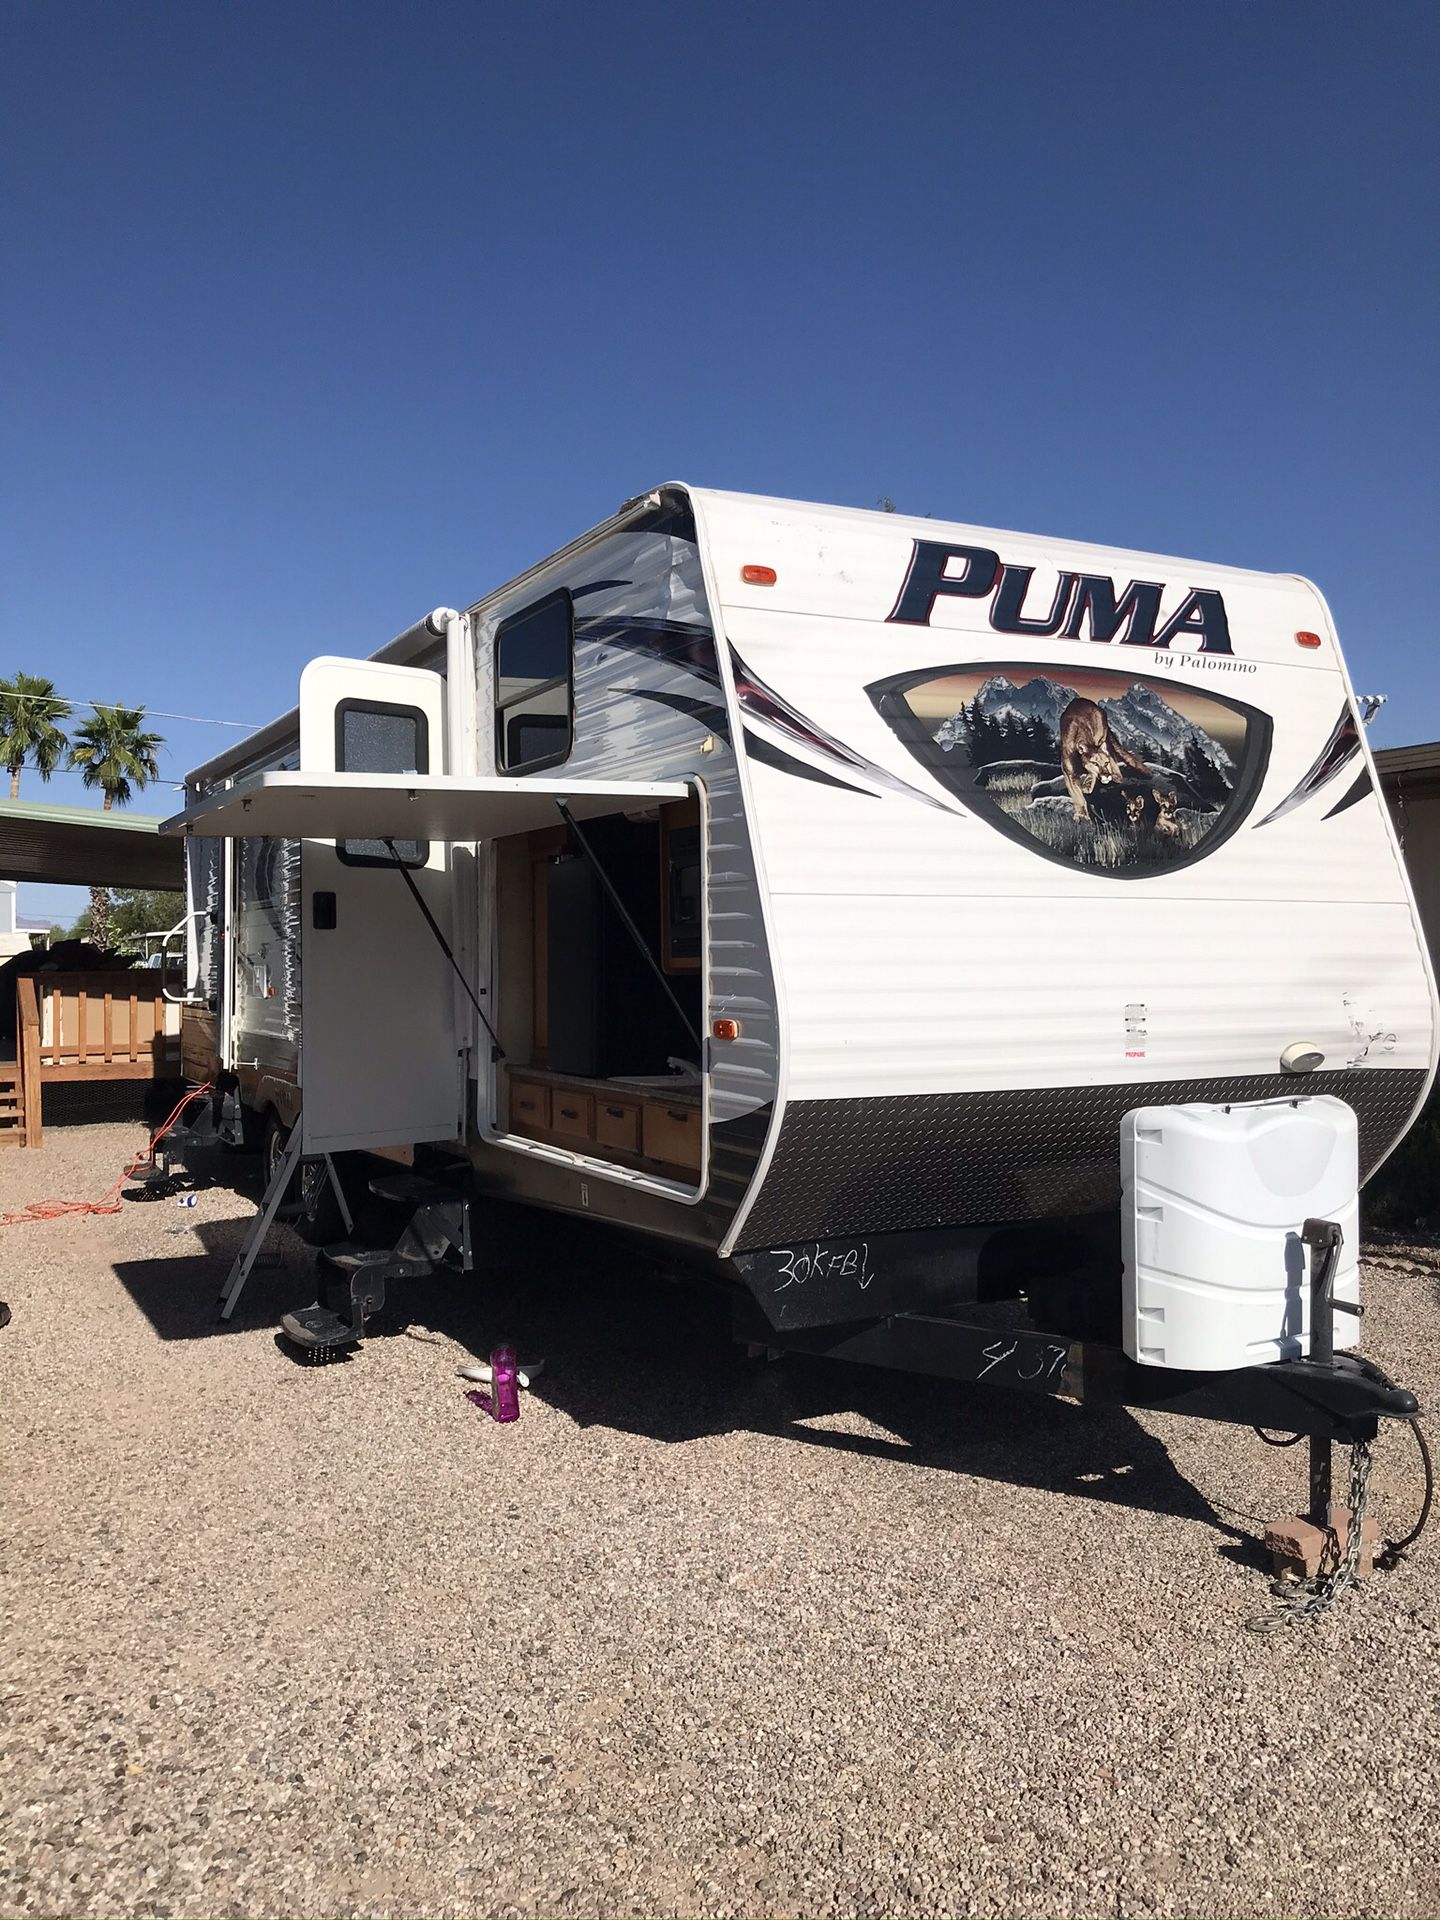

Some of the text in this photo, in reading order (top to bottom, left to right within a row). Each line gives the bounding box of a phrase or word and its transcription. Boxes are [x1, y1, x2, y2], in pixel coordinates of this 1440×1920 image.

[884, 538, 1234, 655] PUMA
[1154, 652, 1257, 673] by Palomino
